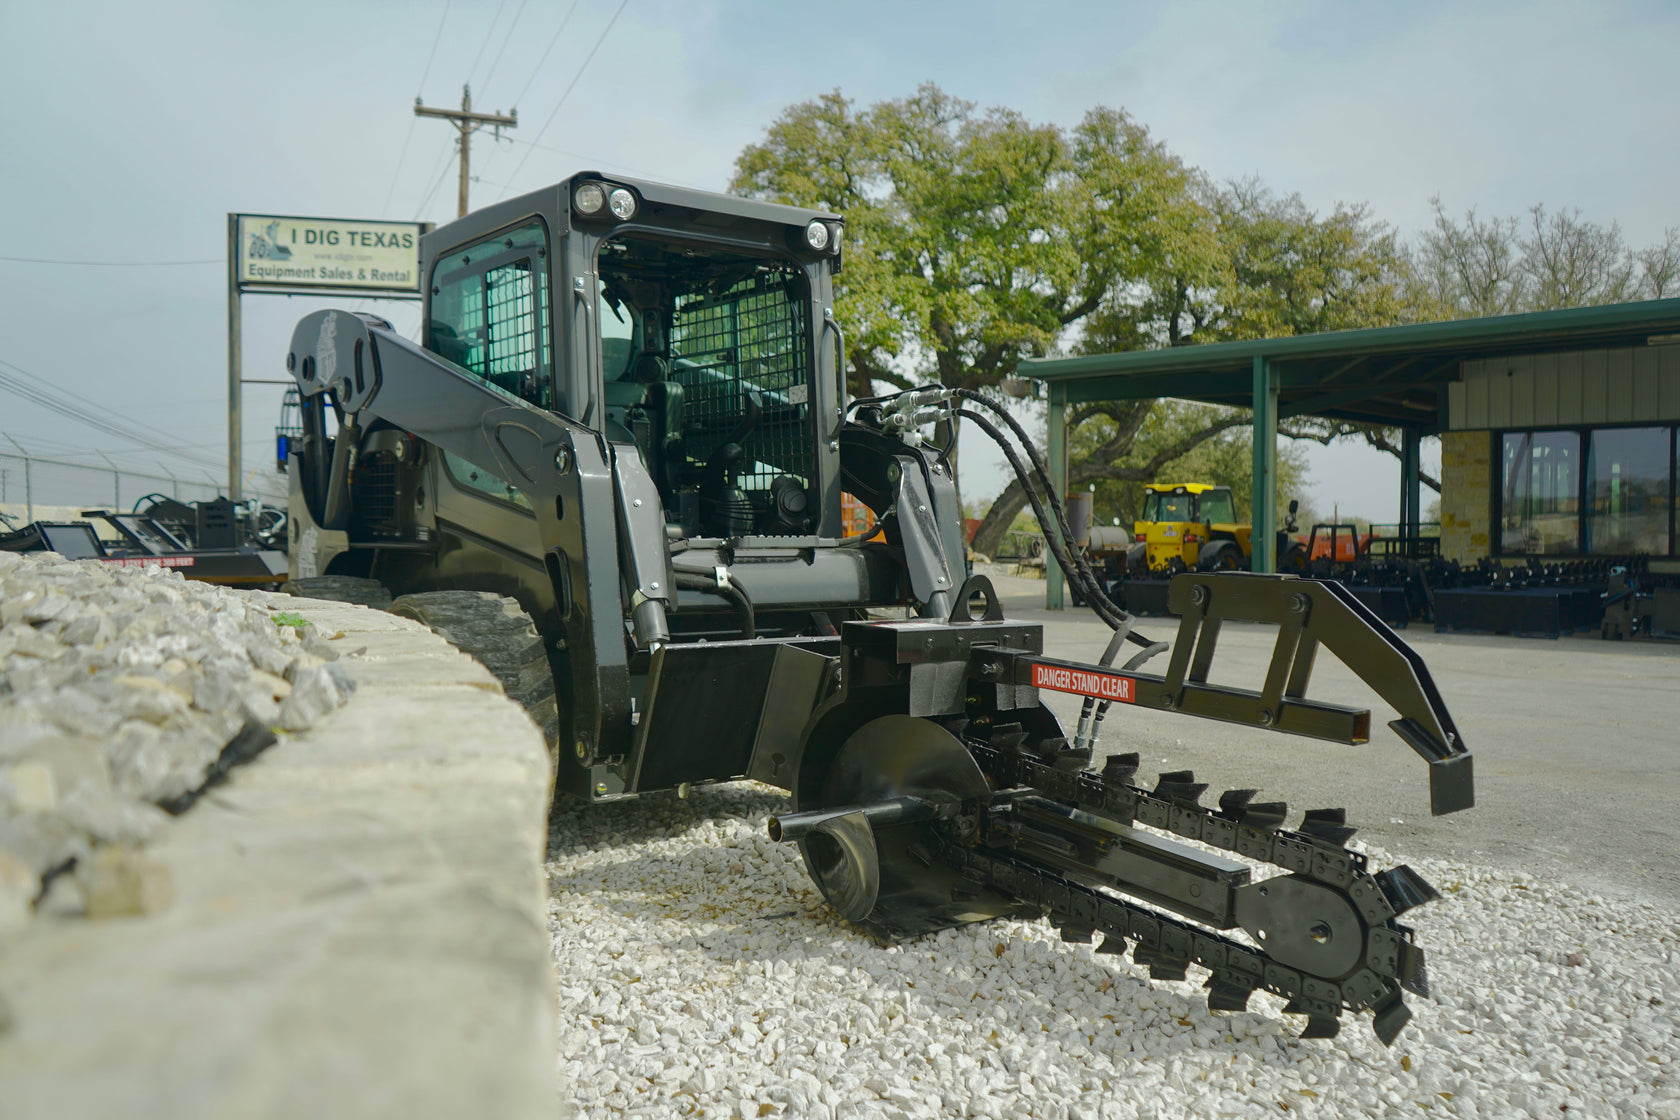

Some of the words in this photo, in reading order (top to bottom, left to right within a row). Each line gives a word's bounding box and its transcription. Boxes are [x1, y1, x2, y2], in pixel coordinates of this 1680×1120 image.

[292, 229, 296, 244] I
[305, 229, 340, 246] DIG
[347, 231, 413, 249] TEXAS
[249, 263, 315, 280] Equipment
[319, 266, 353, 280] Sales
[358, 268, 366, 281] &
[371, 268, 411, 282] Rental
[1037, 667, 1071, 689] DANGER
[1072, 672, 1100, 694] STAND
[1101, 677, 1129, 699] CLEAR
